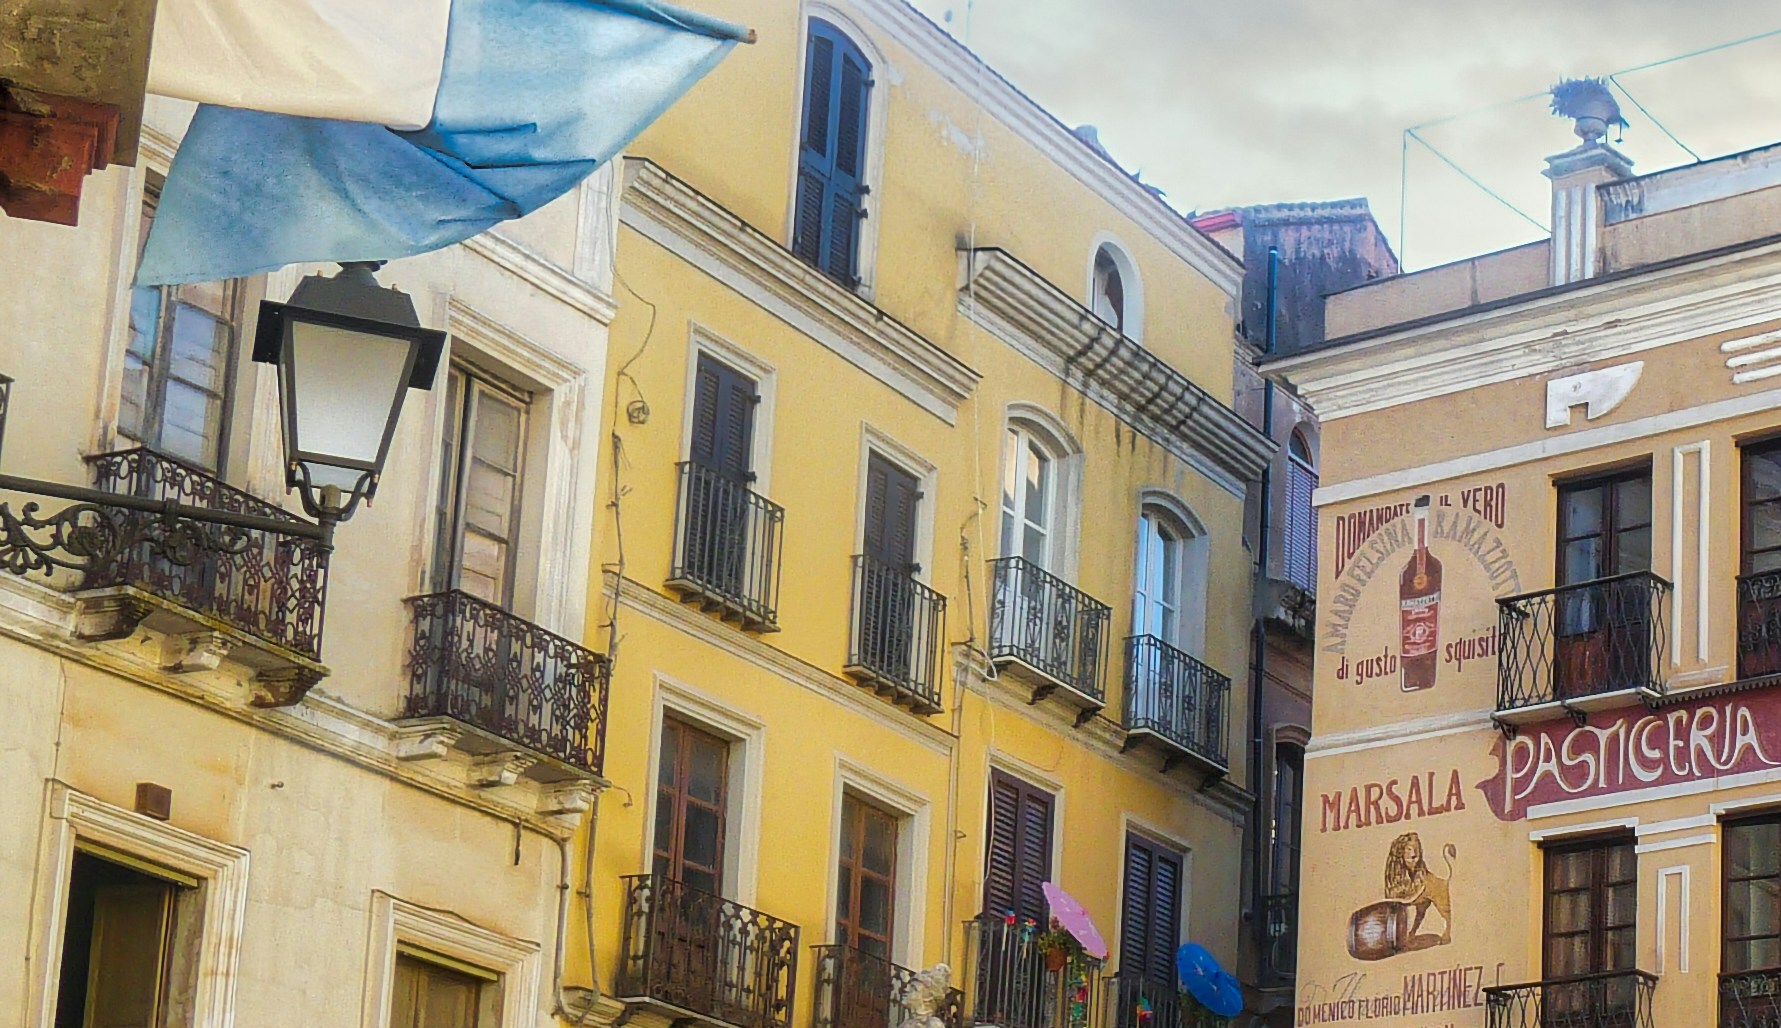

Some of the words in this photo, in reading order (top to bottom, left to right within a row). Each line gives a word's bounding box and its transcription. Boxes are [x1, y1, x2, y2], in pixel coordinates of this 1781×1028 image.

[1334, 502, 1412, 580] DOMANDATE
[1439, 494, 1452, 507] IL
[1460, 482, 1506, 530] VERO
[1322, 582, 1361, 655] AMARO
[1346, 518, 1414, 587] FELSINA
[1433, 510, 1522, 598] RAMAZZOTT
[1336, 655, 1349, 680] di
[1355, 645, 1397, 686] gusto
[1444, 624, 1500, 673] squisit
[1319, 768, 1466, 834] MARSALA
[1296, 998, 1356, 1028] DOMENICO
